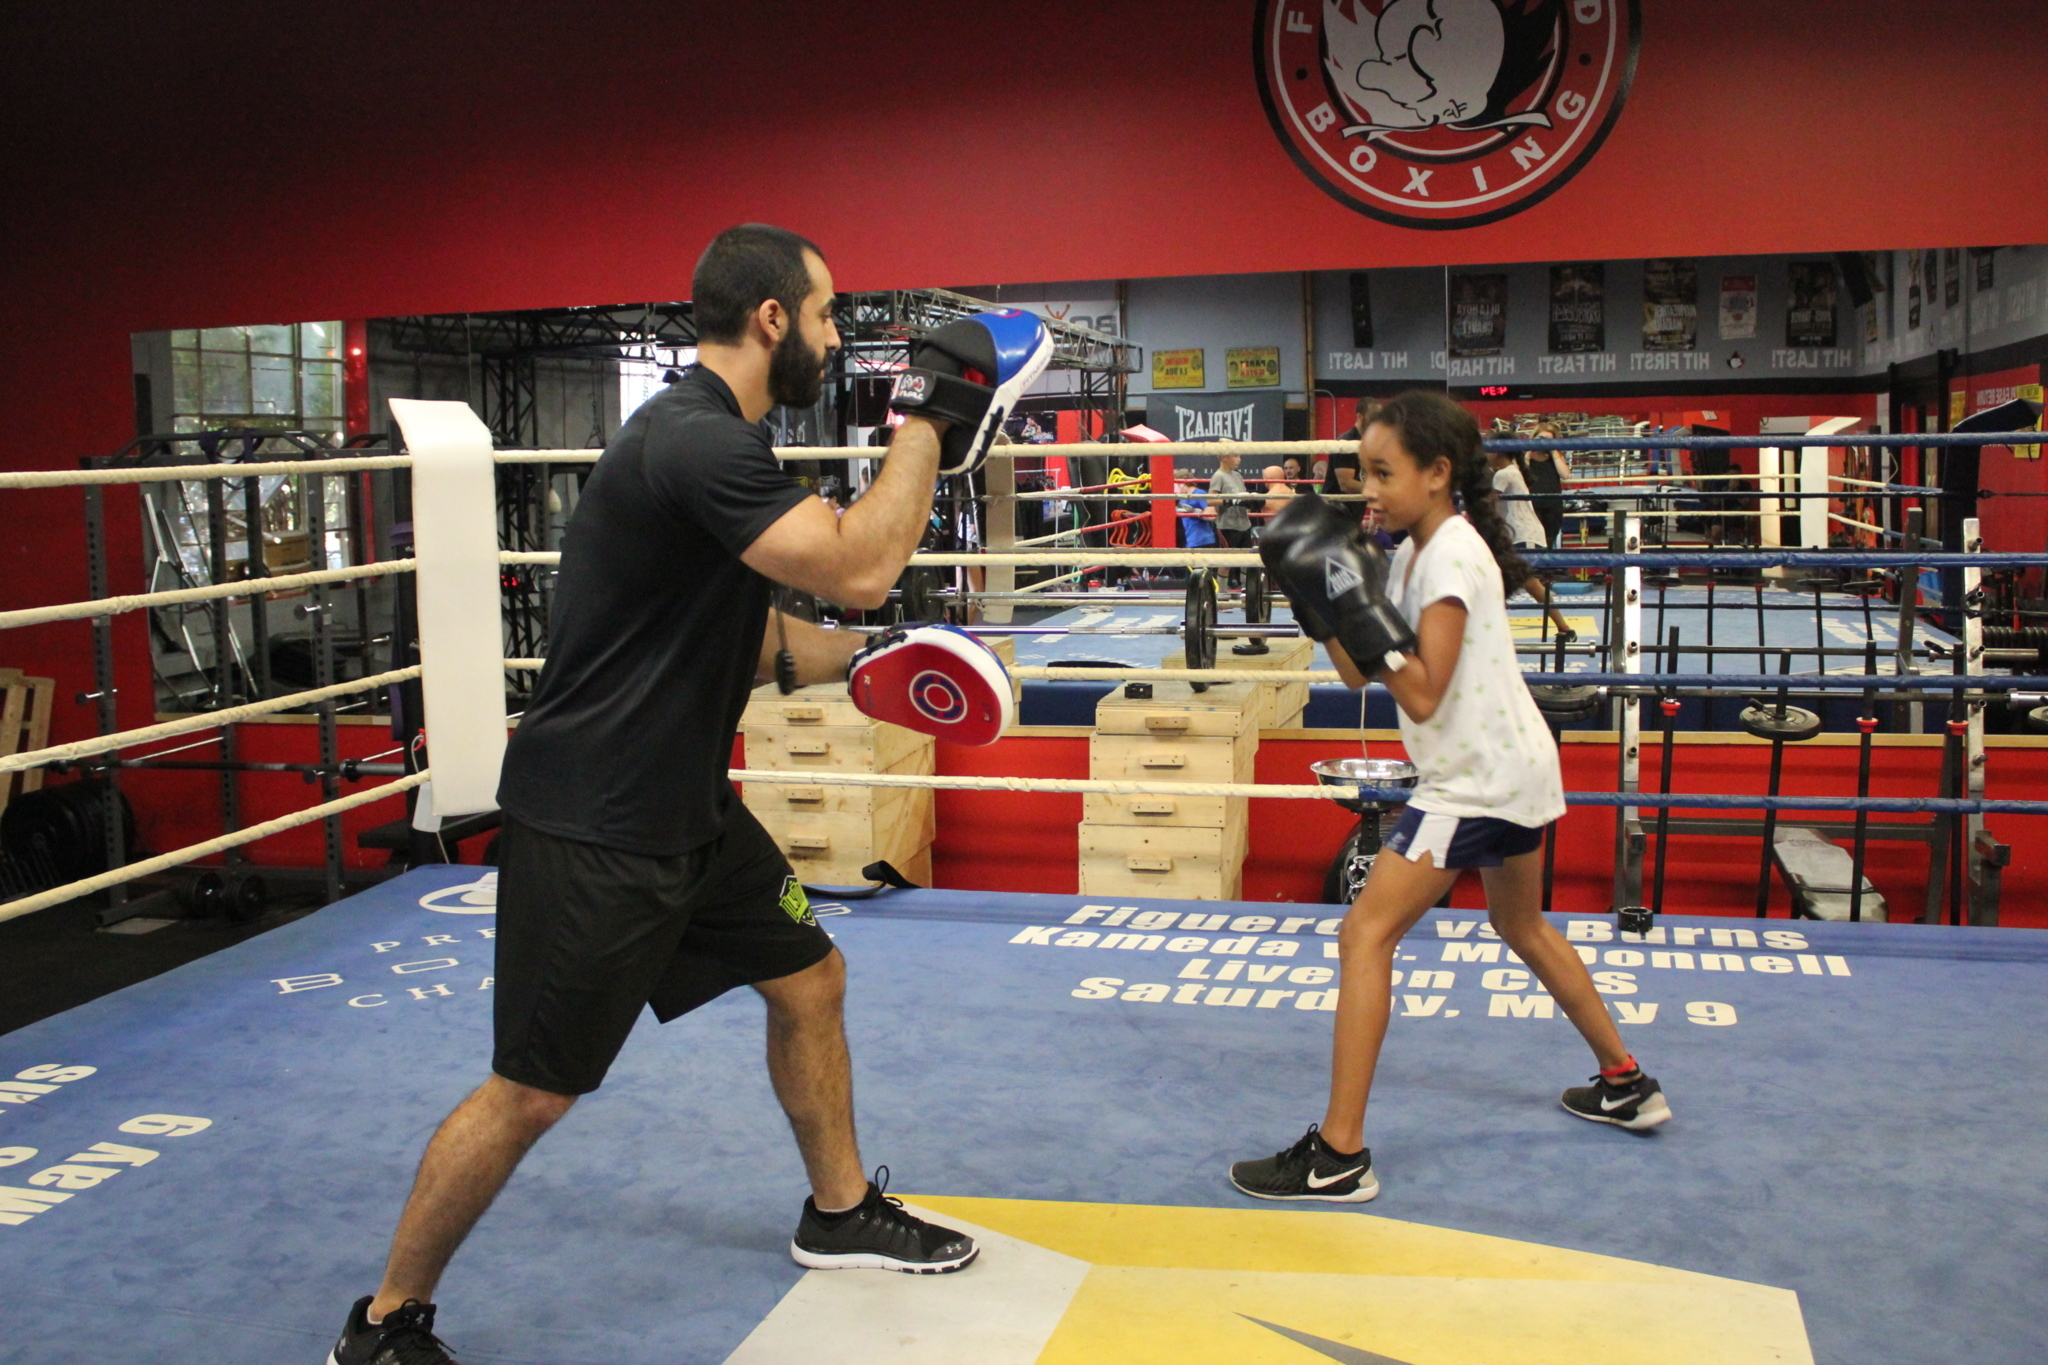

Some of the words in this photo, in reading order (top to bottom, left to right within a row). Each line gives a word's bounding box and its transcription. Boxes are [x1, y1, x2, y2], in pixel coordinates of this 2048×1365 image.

[1305, 90, 1587, 197] BOXING
[1008, 926, 1300, 957] Kameda
[1063, 905, 1406, 937] Figuero
[1566, 920, 1809, 950] Burns
[1177, 958, 1335, 985] Live
[1481, 968, 1638, 995] CS
[1071, 977, 1460, 1018] Saturdy,
[1488, 994, 1659, 1024] My
[1686, 1001, 1738, 1026] 9
[118, 1113, 213, 1137] 9
